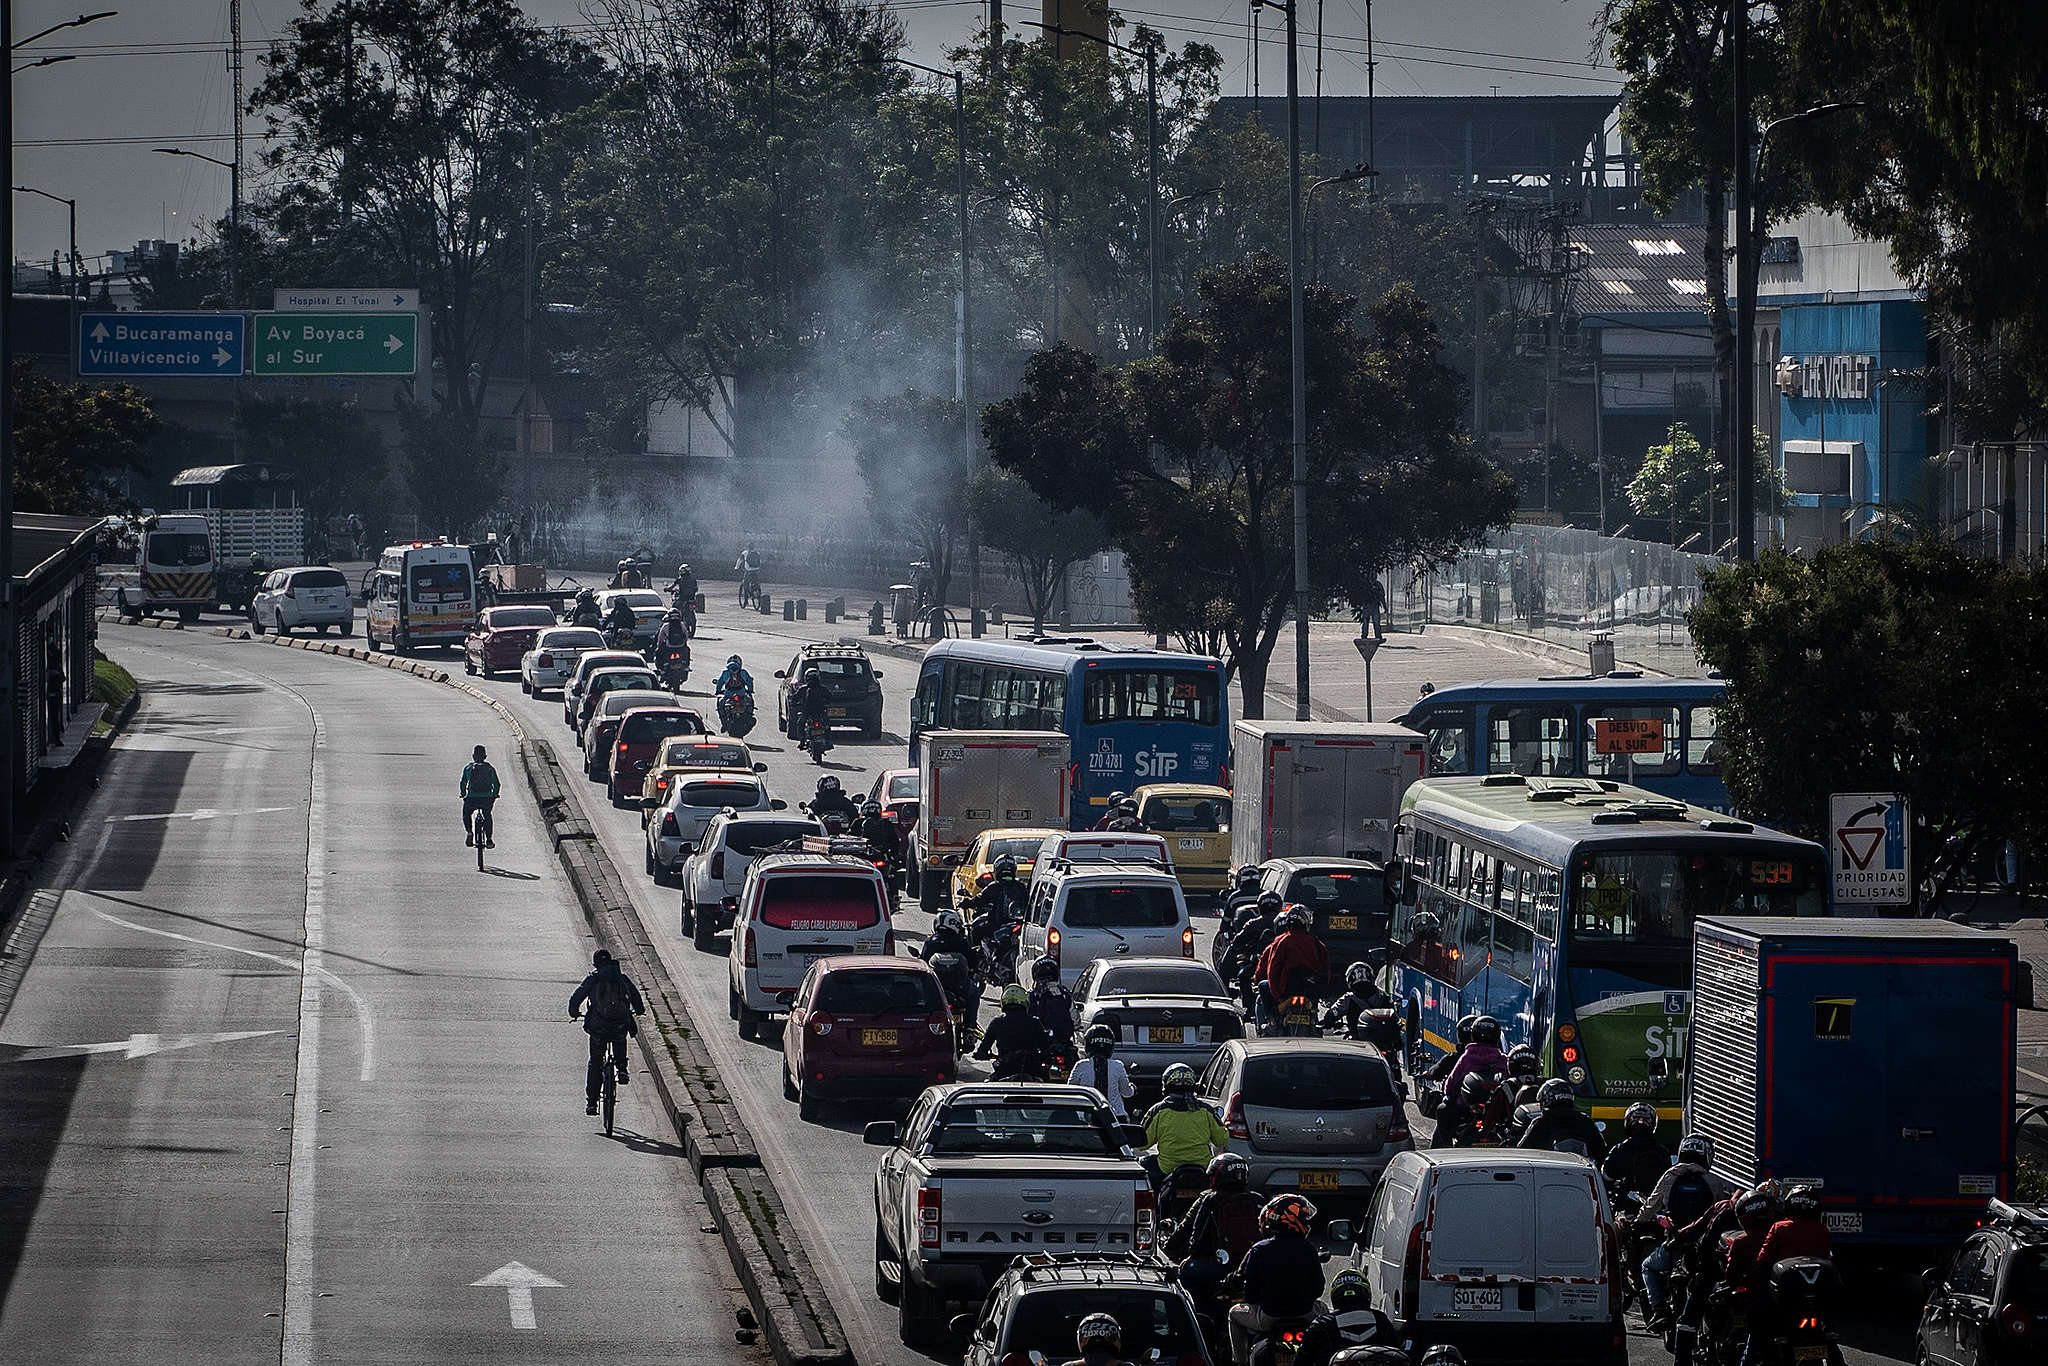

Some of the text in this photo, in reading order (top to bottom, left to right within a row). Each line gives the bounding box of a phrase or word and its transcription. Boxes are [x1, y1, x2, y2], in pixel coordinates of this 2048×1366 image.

[289, 295, 380, 307] Hospital El Tunal
[116, 326, 234, 343] Bucaramanga
[267, 325, 365, 344] Av Boyacá
[89, 349, 201, 365] Villavicencio
[266, 349, 323, 364] al Sur
[1802, 355, 1870, 399] CHEVROLET
[1608, 722, 1648, 733] DESVIO
[1609, 740, 1647, 750] AL SUR
[1105, 753, 1123, 769] 4781
[1836, 872, 1906, 883] PRIORIDAD
[1837, 887, 1905, 898] CICLISTAS
[791, 920, 810, 931] PELIGRO
[811, 920, 826, 931] CARGA
[1645, 1017, 1688, 1058] SiT
[1823, 1212, 1863, 1228] OU-523
[946, 1231, 1130, 1243] RANGER
